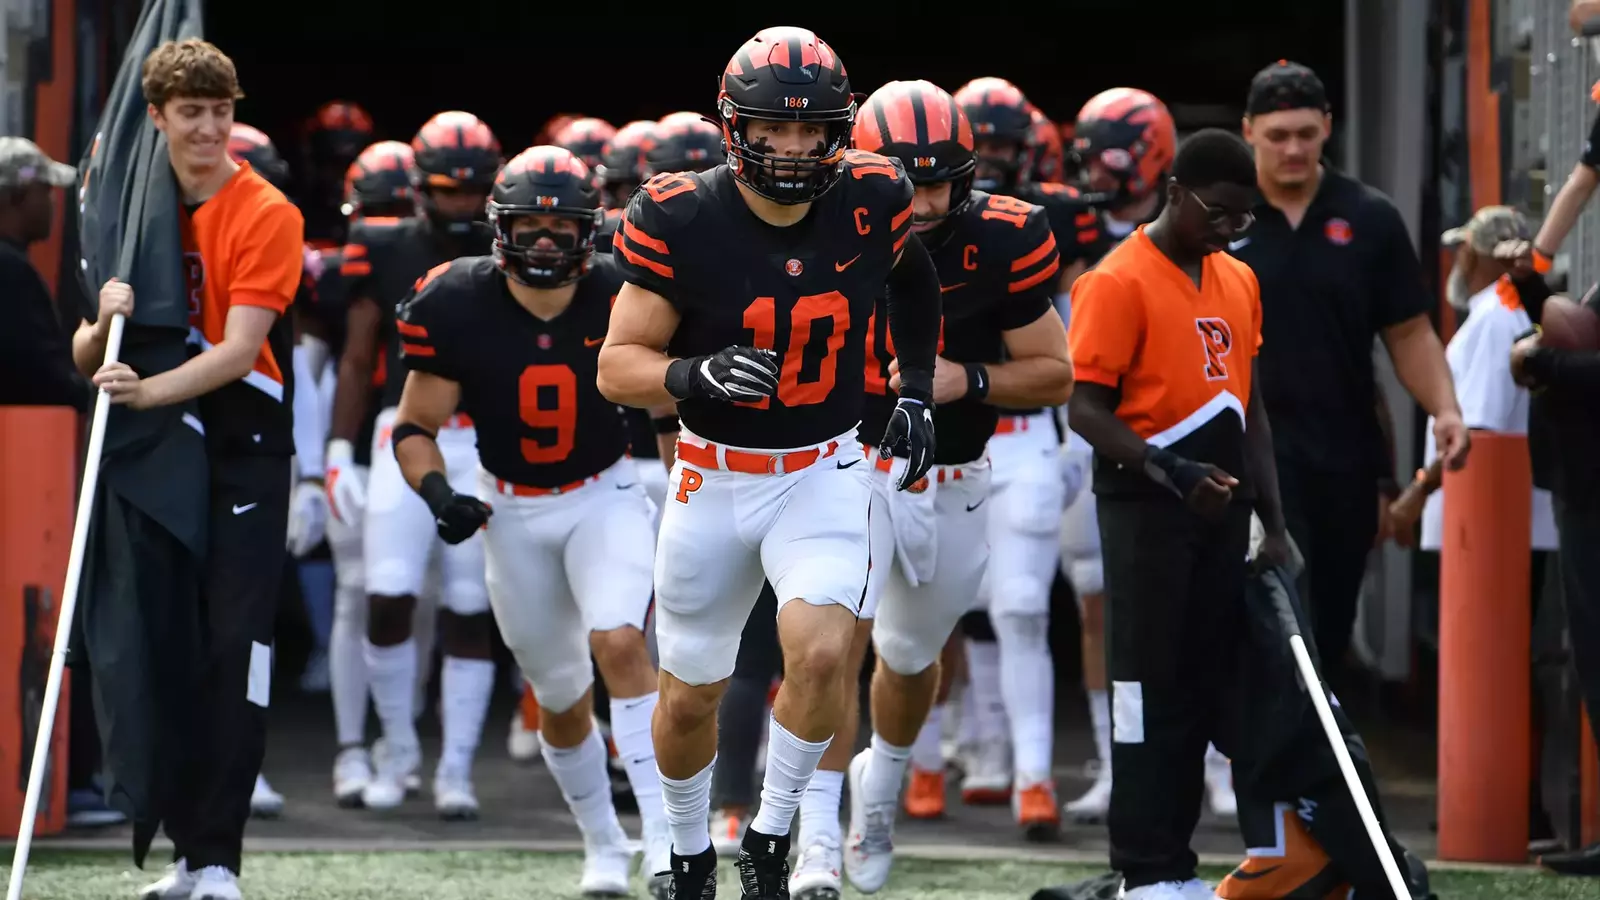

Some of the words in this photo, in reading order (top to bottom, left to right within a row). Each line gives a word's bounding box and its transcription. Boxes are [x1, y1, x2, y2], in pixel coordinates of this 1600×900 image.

[784, 96, 809, 109] 1869
[913, 156, 937, 168] 1869
[853, 207, 871, 235] C
[982, 194, 1032, 229] 18
[963, 245, 979, 270] C
[733, 290, 850, 410] 10
[1195, 317, 1232, 381] P
[519, 364, 577, 463] 9
[675, 468, 704, 504] P
